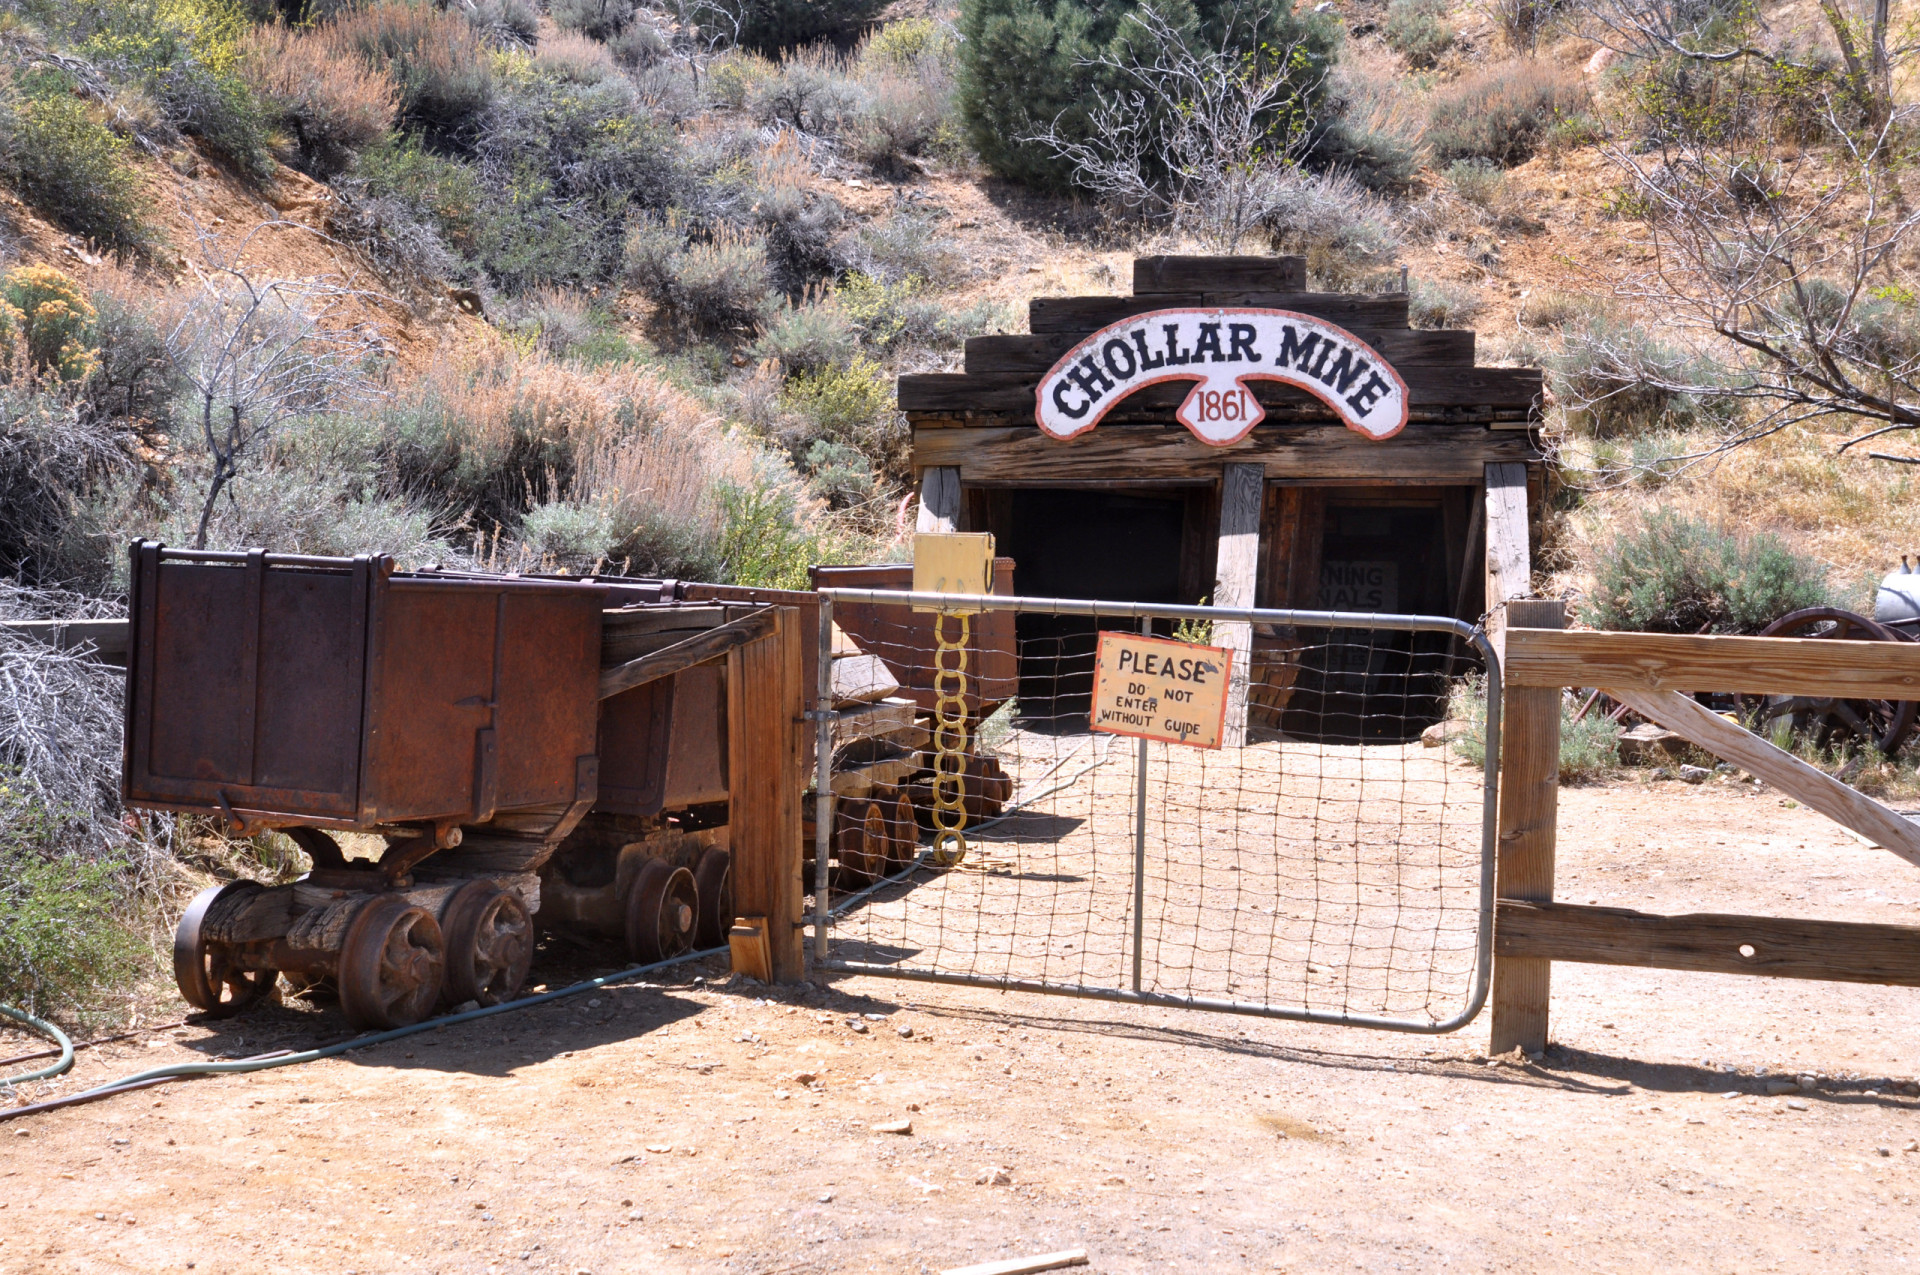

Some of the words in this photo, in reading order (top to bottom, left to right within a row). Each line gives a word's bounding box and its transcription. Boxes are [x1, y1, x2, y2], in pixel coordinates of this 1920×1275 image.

[1053, 323, 1262, 420] CHOLLAR
[1275, 325, 1391, 418] MINE
[1197, 390, 1247, 422] 1861
[1118, 649, 1206, 684] PLEASE
[1116, 697, 1158, 713] ENTER
[1127, 682, 1146, 696] DO
[1163, 688, 1194, 703] NOT
[1101, 709, 1153, 727] WITHOUT
[1164, 719, 1201, 735] GUIDE
